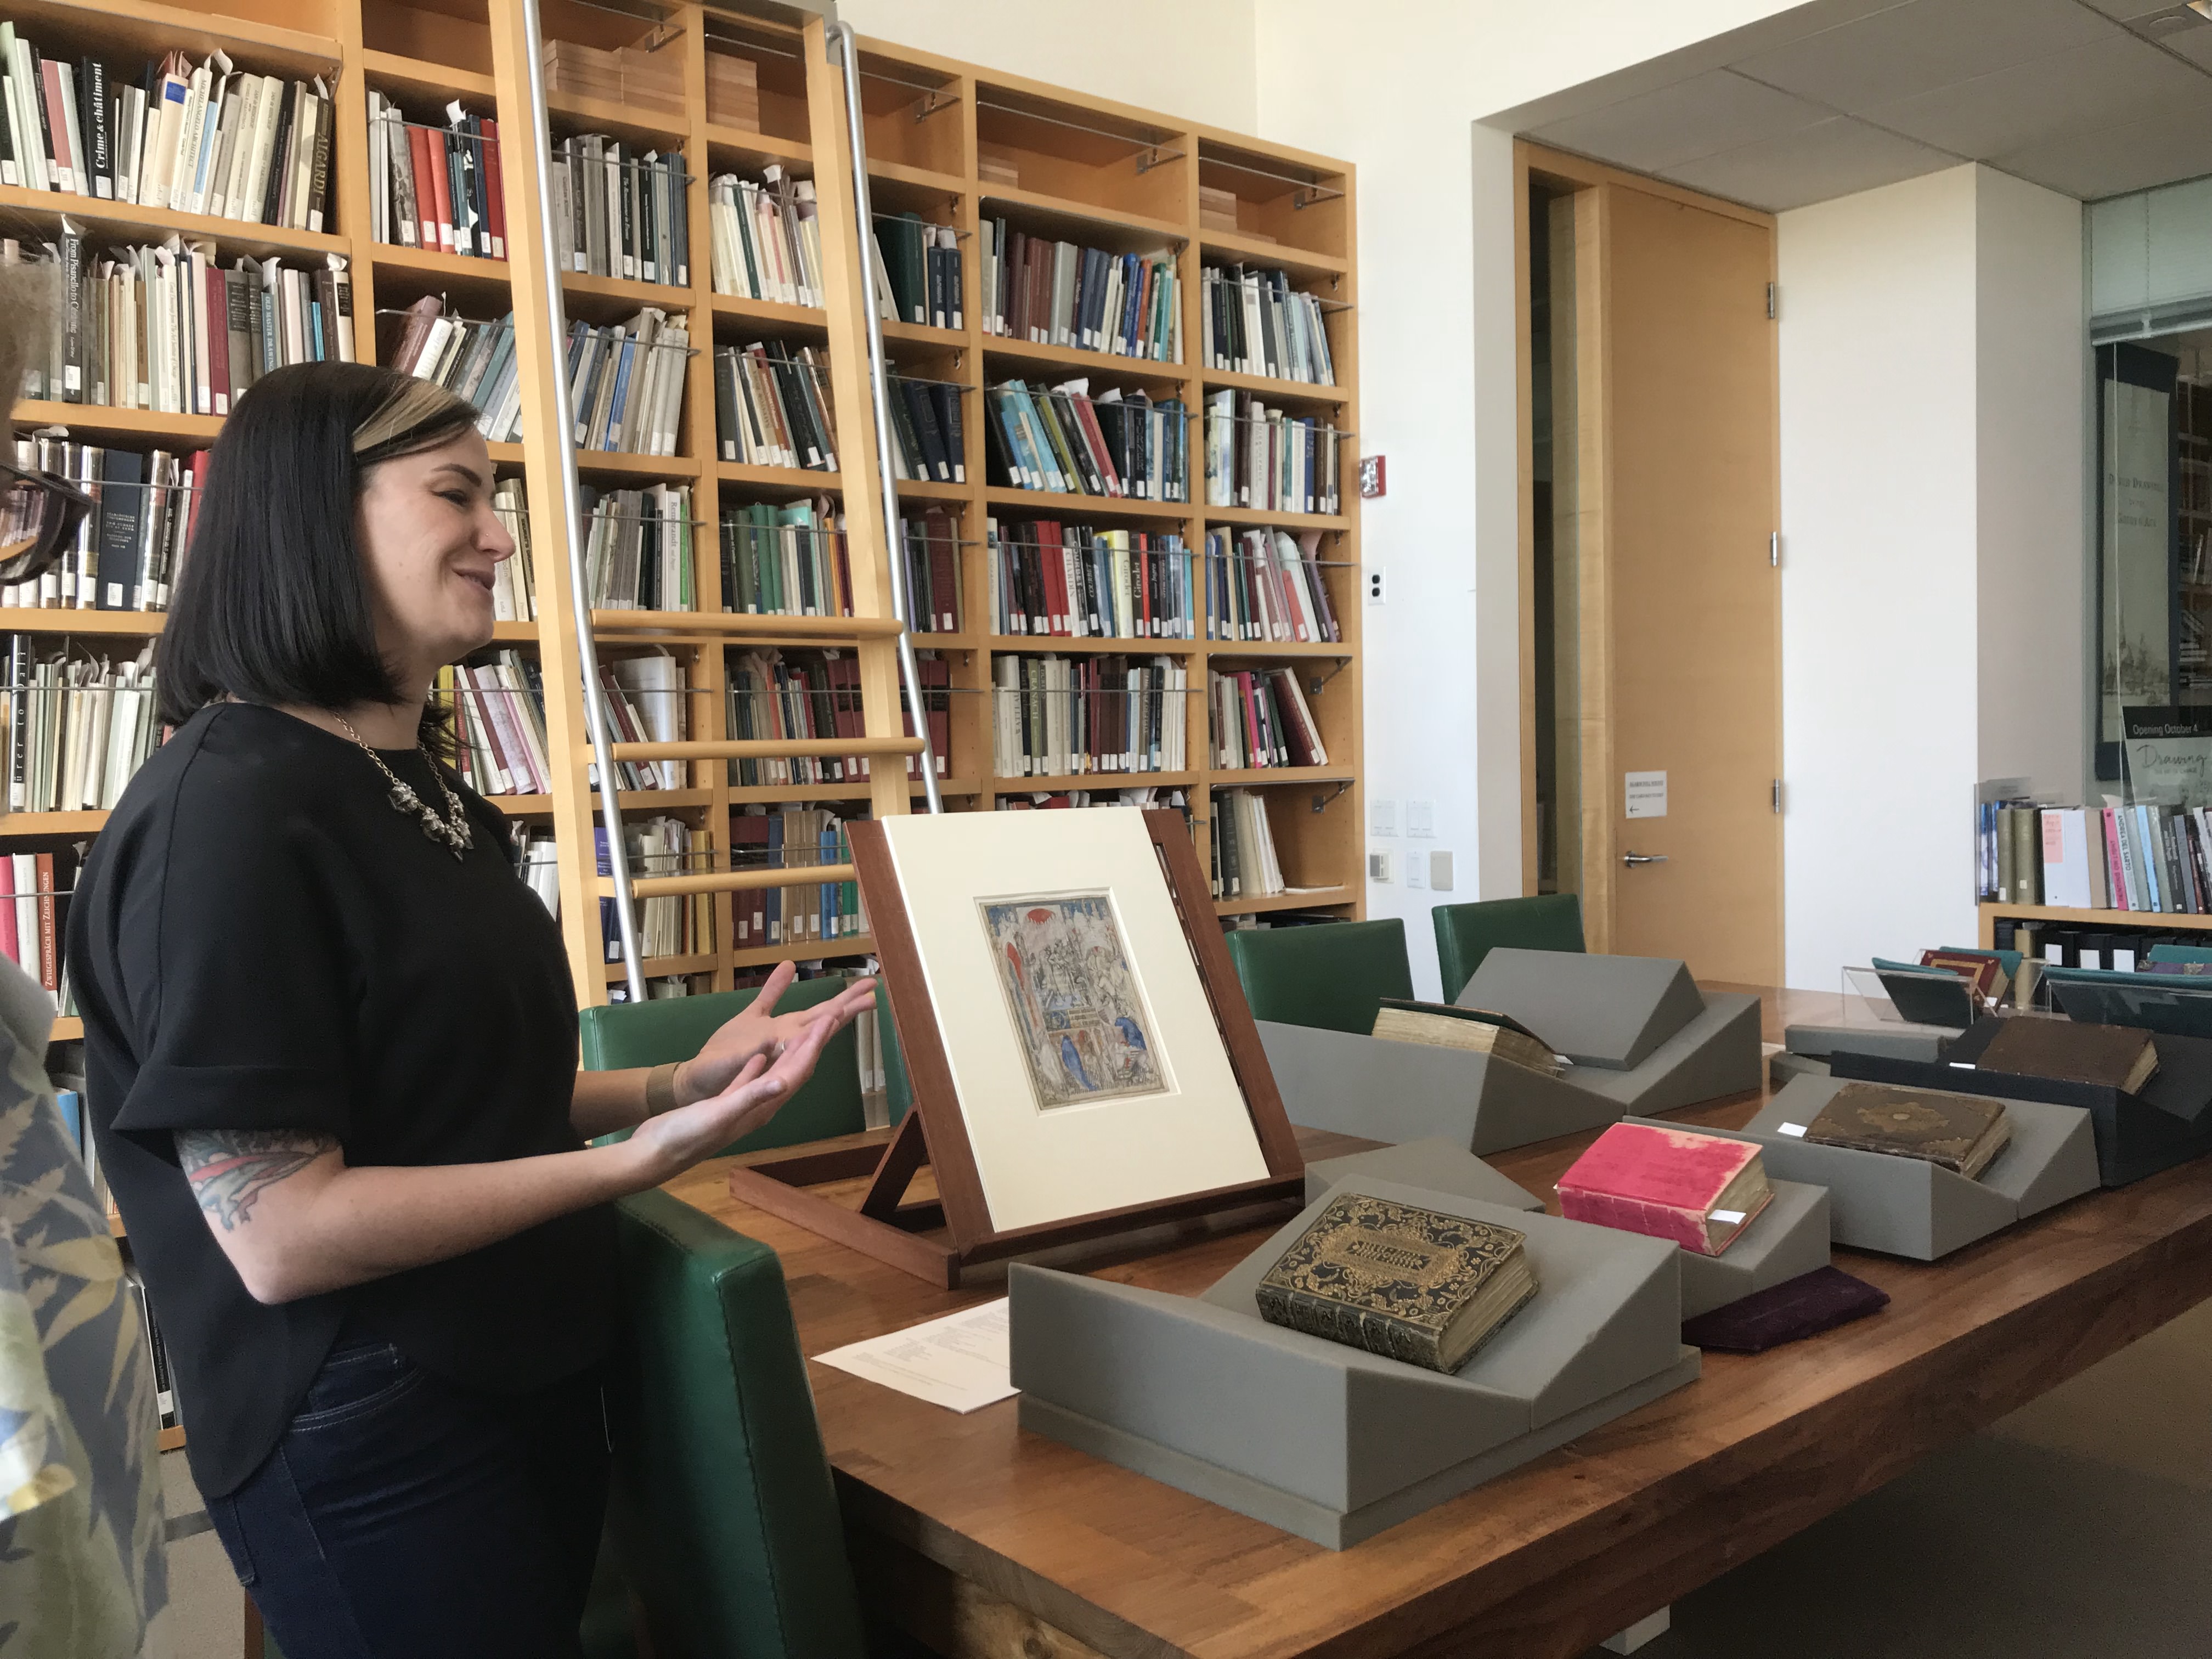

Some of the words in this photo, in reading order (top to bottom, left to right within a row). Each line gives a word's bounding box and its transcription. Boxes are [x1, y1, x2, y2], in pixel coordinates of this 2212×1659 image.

[92, 63, 103, 123] châtiment
[194, 78, 207, 131] MICHELANGELO
[97, 124, 104, 132] &
[95, 133, 105, 169] Crime
[188, 131, 198, 169] ARCHITECT
[313, 132, 329, 195] ALGARDI
[70, 238, 79, 257] From
[70, 259, 79, 291] Pisanello
[1065, 552, 1075, 597] CHARDIN
[1073, 541, 1082, 587] COURBET
[1086, 562, 1094, 597] COURBET
[1132, 562, 1142, 598] Girodet
[17, 708, 24, 725] to
[2133, 724, 2163, 736] Opening
[2164, 724, 2192, 734] October
[14, 742, 22, 781] ürer
[2137, 744, 2207, 777] Drawing
